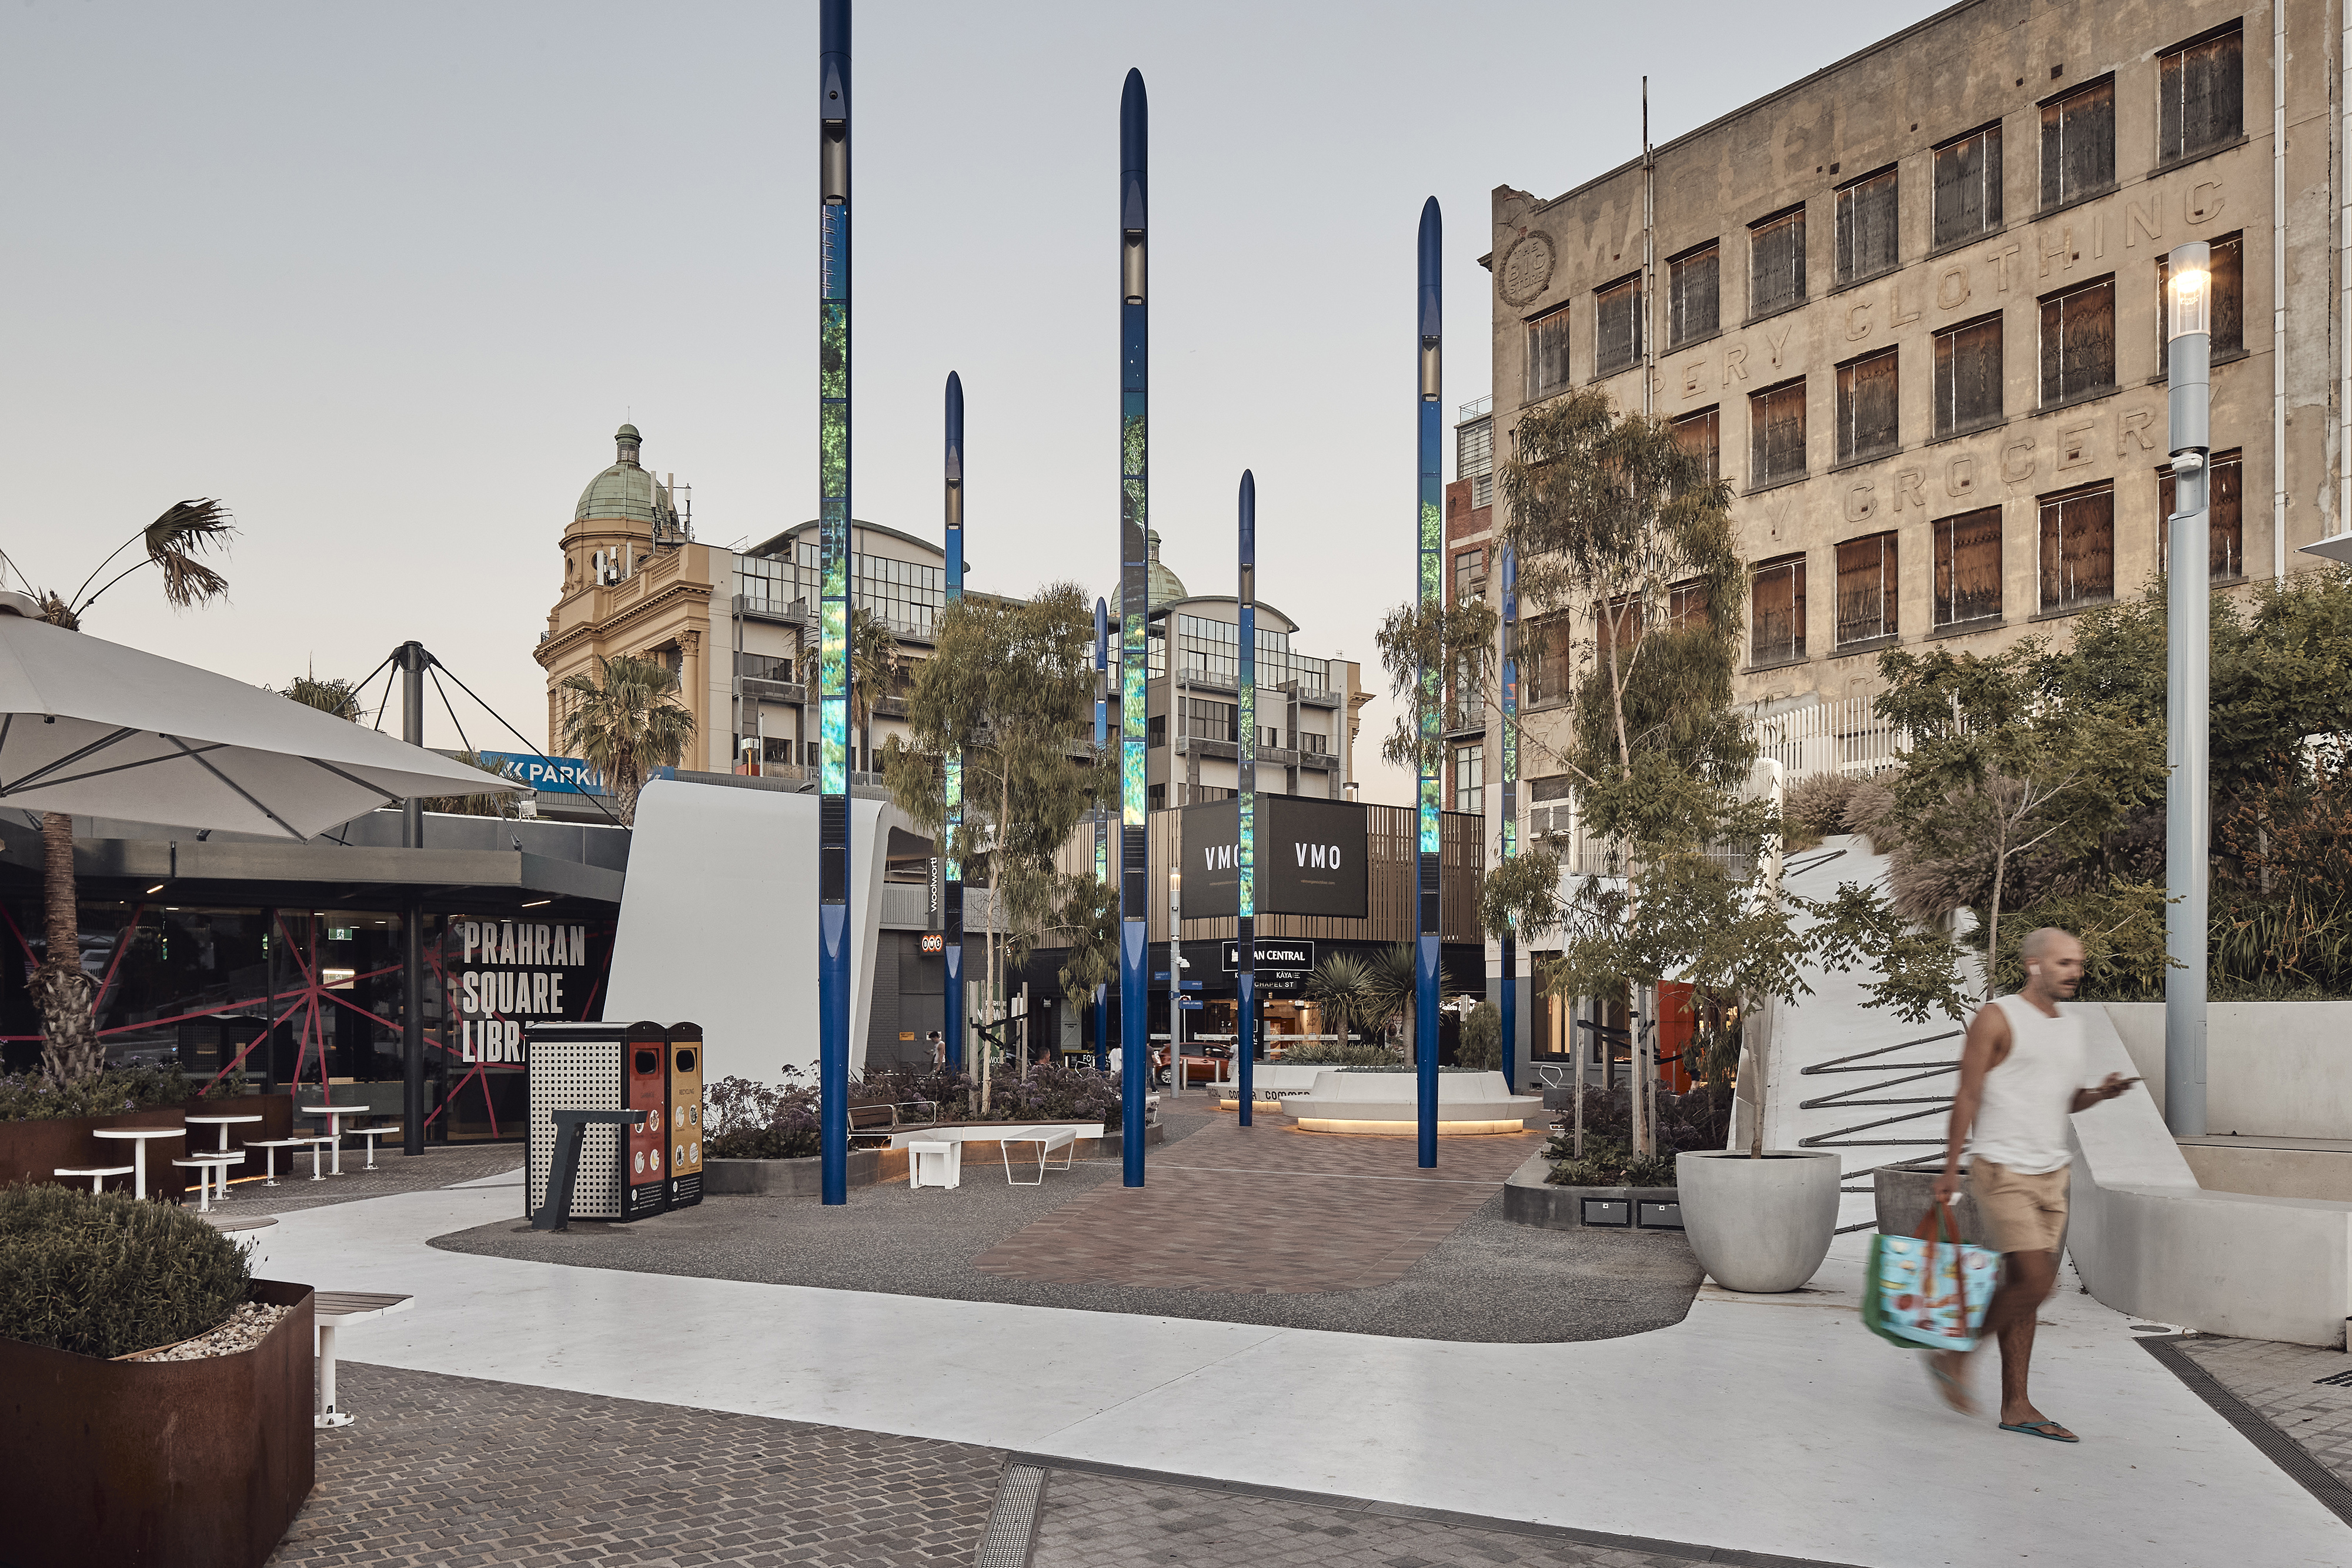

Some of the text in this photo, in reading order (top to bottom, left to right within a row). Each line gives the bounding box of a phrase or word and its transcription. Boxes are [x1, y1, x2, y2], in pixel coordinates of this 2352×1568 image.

[1514, 242, 1538, 260] THE
[1844, 174, 2226, 342] CLOTHING
[1509, 270, 1545, 295] STORE
[1846, 384, 2220, 523] GROCER
[530, 763, 613, 787] PARKI
[1295, 842, 1340, 870] VMO
[464, 921, 585, 966] PRAHRAN
[1254, 951, 1305, 961] AN CENTRAL
[463, 971, 563, 1019] SQUARE
[463, 1021, 559, 1062] LIBR
